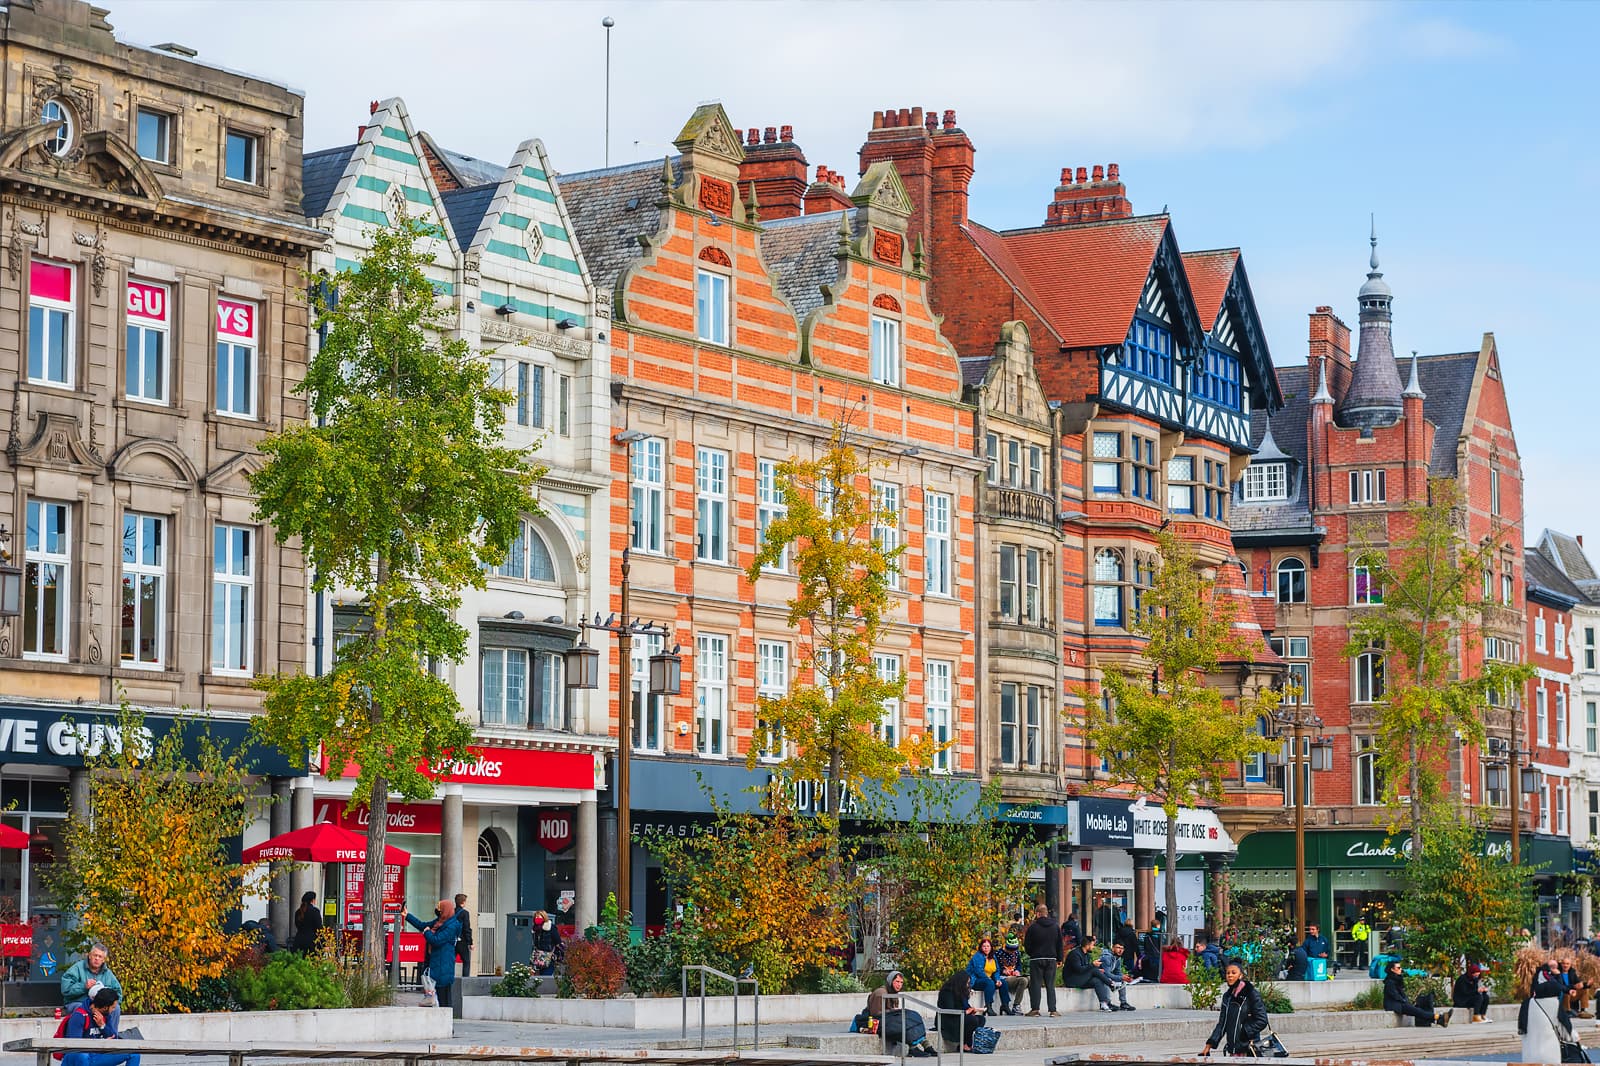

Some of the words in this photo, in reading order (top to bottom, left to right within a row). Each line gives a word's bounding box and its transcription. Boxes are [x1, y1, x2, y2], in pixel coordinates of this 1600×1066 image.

[431, 756, 502, 778] Lbrokes
[814, 778, 858, 813] PIZA
[358, 808, 416, 828] Larokes
[1086, 813, 1112, 831] Mobile
[1113, 815, 1128, 832] Lab
[540, 819, 569, 839] MOD
[1134, 819, 1151, 835] WHITE
[1153, 820, 1168, 836] ROSE
[1191, 824, 1206, 839] ROSE
[259, 848, 274, 858] FIVE
[274, 847, 293, 857] GUYS
[336, 850, 358, 859] FIVE
[1346, 841, 1397, 857] Clarks
